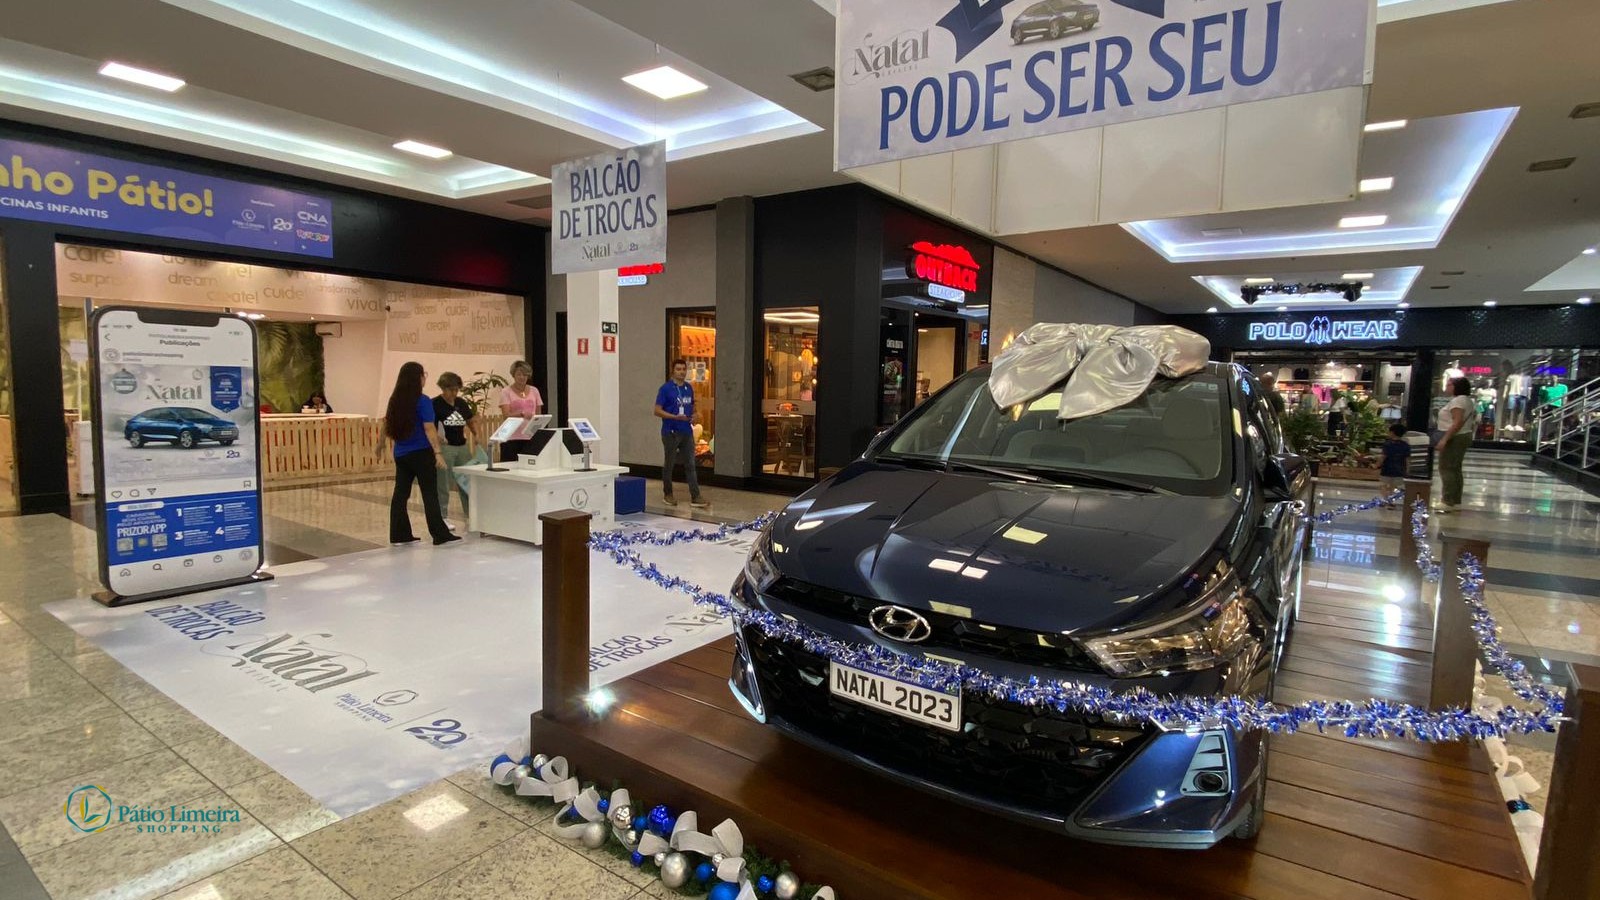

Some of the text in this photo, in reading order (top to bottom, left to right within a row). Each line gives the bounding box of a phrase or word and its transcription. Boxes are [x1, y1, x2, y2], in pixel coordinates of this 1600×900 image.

[852, 28, 930, 78] Natal
[879, 0, 1283, 150] PODE SER SEU
[87, 168, 214, 217] Pátio!
[570, 156, 641, 203] BALCÃO
[47, 203, 109, 219] INFANTIS
[297, 210, 329, 224] CNA
[560, 193, 658, 240] DE TROCAS
[582, 243, 610, 261] Natal
[914, 253, 978, 293] OUTBACK
[1249, 321, 1398, 340] POLO WEAR
[146, 384, 203, 403] Natal
[176, 508, 183, 517] 1
[215, 504, 223, 513] 2
[175, 531, 184, 540] 3
[194, 600, 266, 626] BALCÃO
[159, 612, 234, 641] TROCAS
[589, 635, 642, 660] ALCÃO
[600, 635, 673, 662] TROCAS
[226, 633, 381, 694] Natal
[836, 667, 953, 723] NATAL 2023
